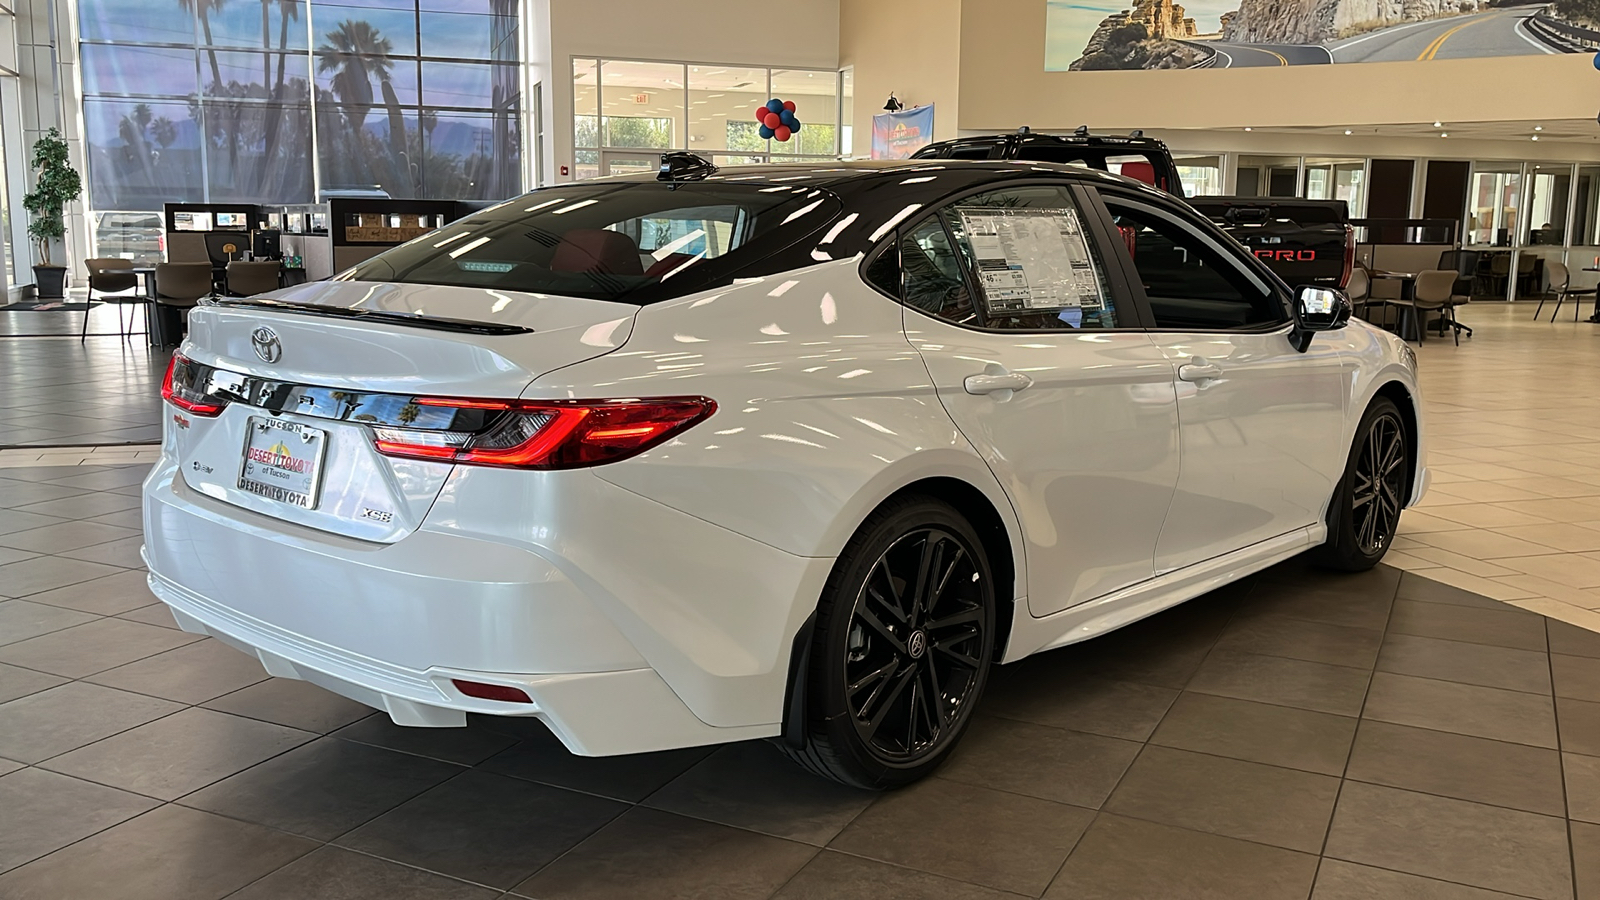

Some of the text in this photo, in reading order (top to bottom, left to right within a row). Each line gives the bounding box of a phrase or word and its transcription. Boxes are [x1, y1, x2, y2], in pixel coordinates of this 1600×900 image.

[1254, 250, 1316, 262] PRO
[266, 419, 302, 433] TUCSON
[248, 448, 277, 466] DESERT
[269, 468, 290, 480] Tucson
[240, 479, 307, 507] DESERT TOYOTA
[361, 507, 393, 523] XSE
